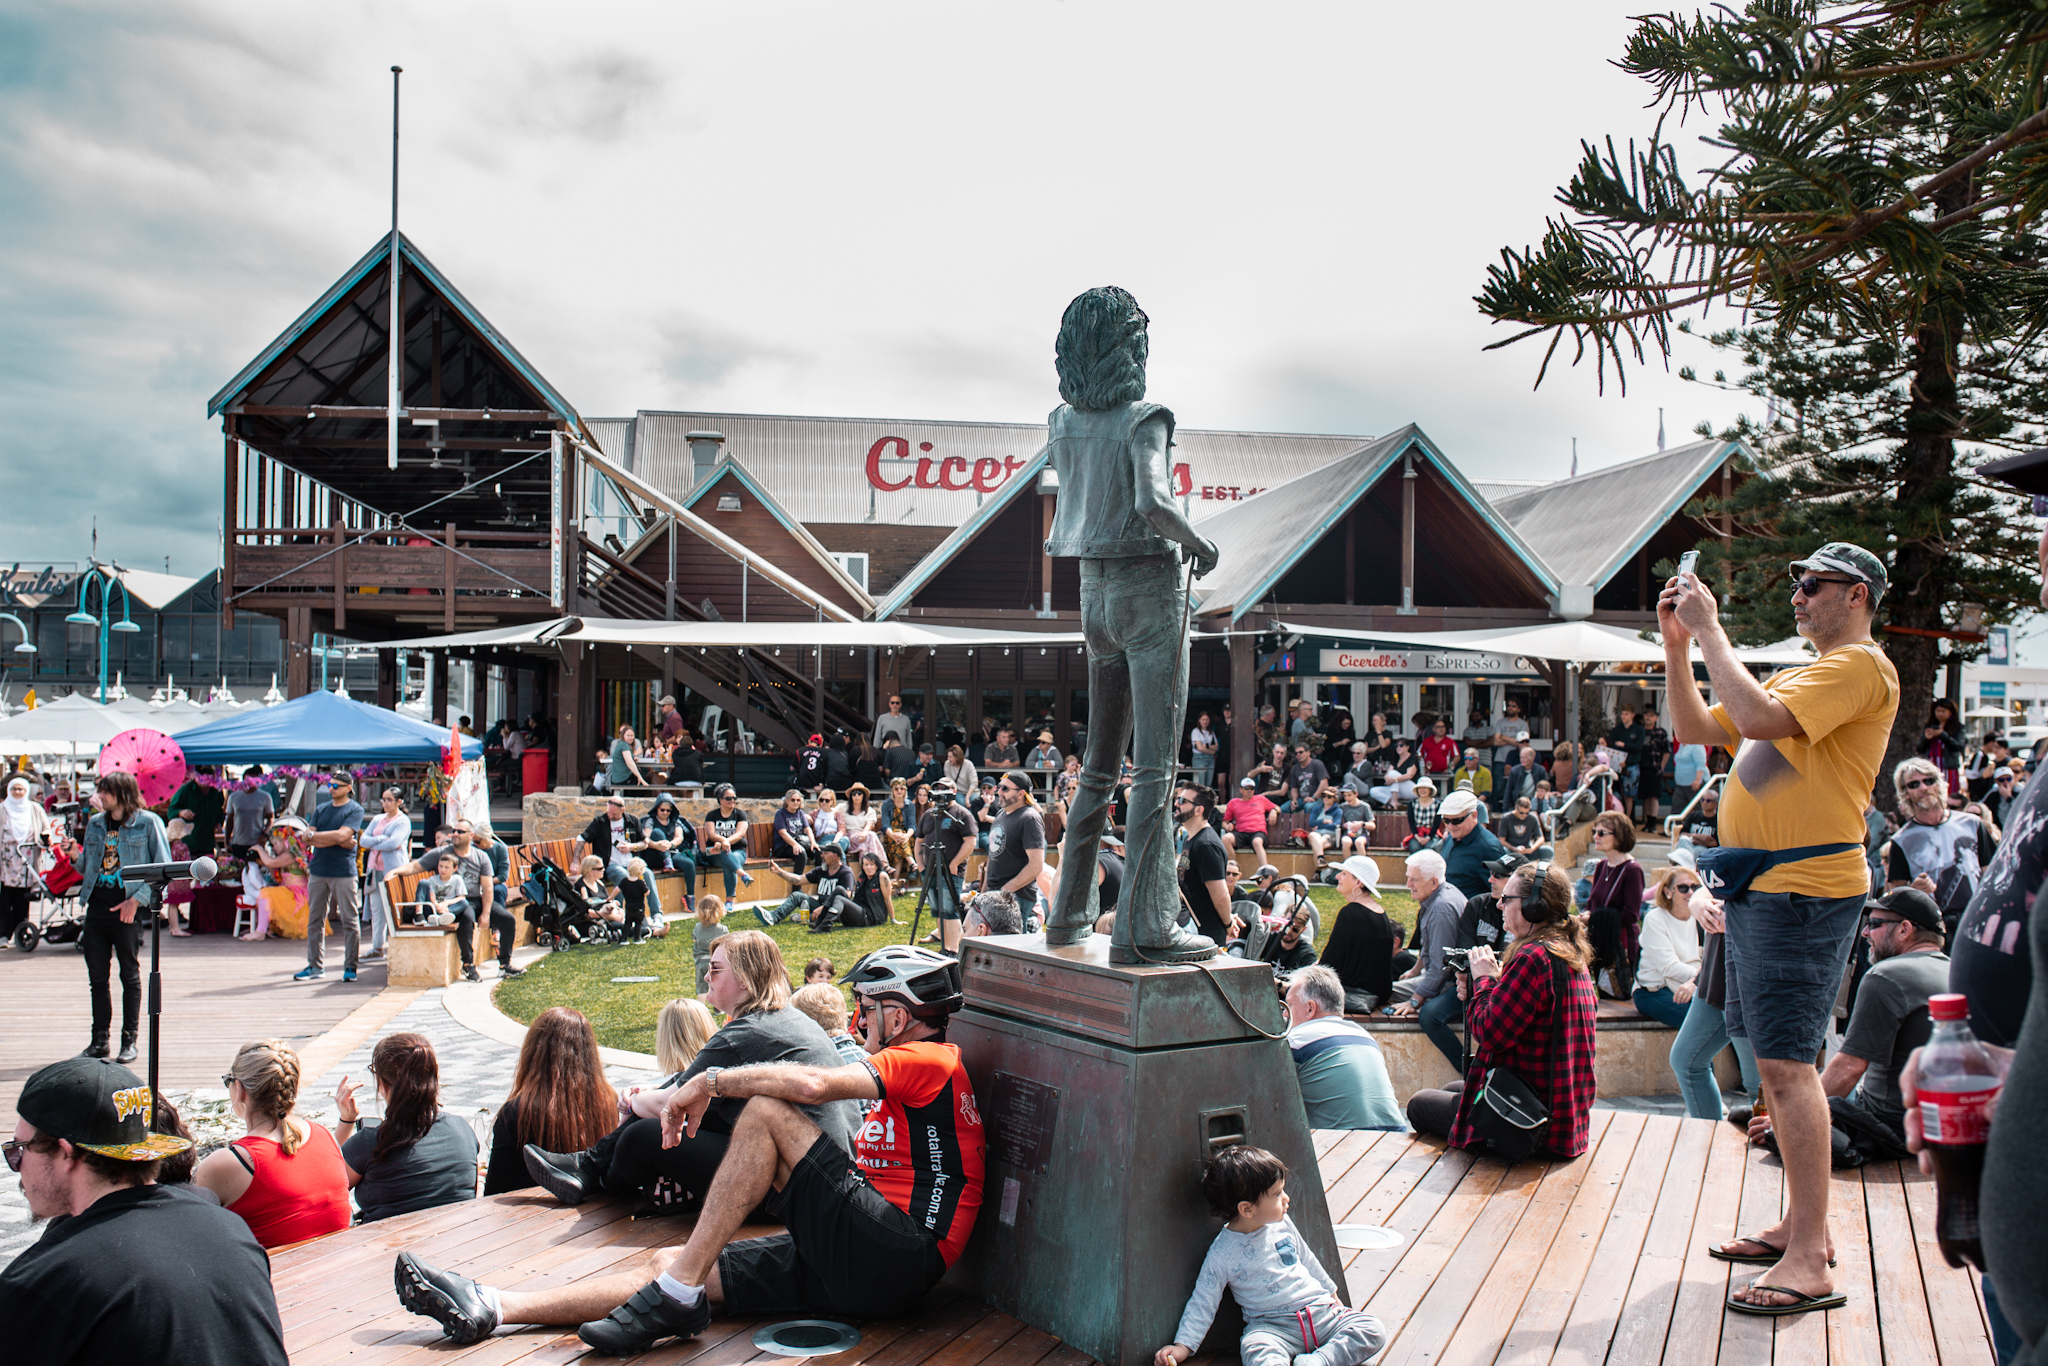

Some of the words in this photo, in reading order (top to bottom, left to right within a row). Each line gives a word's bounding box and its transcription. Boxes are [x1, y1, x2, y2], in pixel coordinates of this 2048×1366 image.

[1201, 486, 1243, 500] EST.
[553, 551, 561, 601] DECK
[1339, 654, 1408, 668] Cicerello's
[1425, 655, 1500, 670] ESPRESSO
[807, 756, 817, 770] 3
[715, 820, 737, 829] LADY
[866, 982, 902, 994] SPECIALIZED
[867, 1143, 879, 1151] Pty
